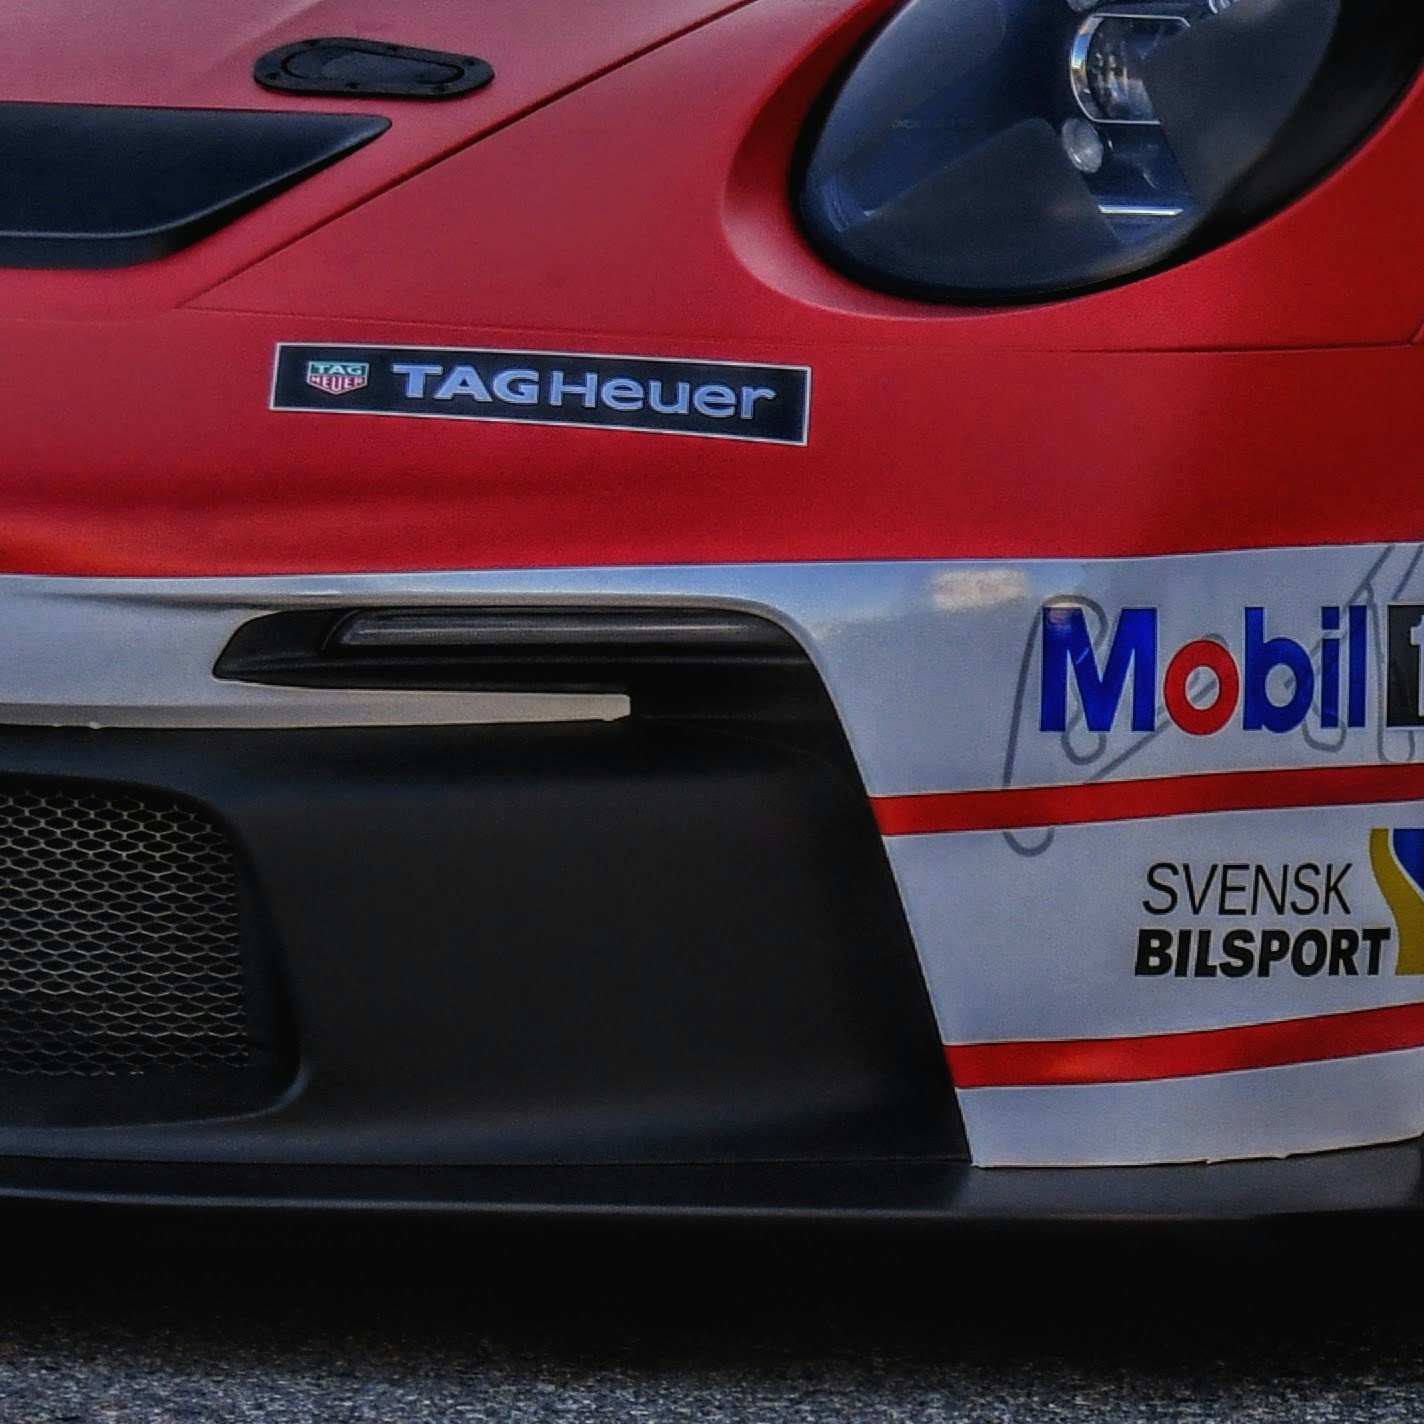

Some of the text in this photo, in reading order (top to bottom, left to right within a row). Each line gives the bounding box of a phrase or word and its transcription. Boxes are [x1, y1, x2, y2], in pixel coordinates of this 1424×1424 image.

[310, 376, 366, 392] HEUER
[313, 364, 363, 375] TAG
[1039, 604, 1368, 736] Mobil
[1142, 862, 1354, 917] SVENSK
[1134, 926, 1393, 978] BILSPORT
